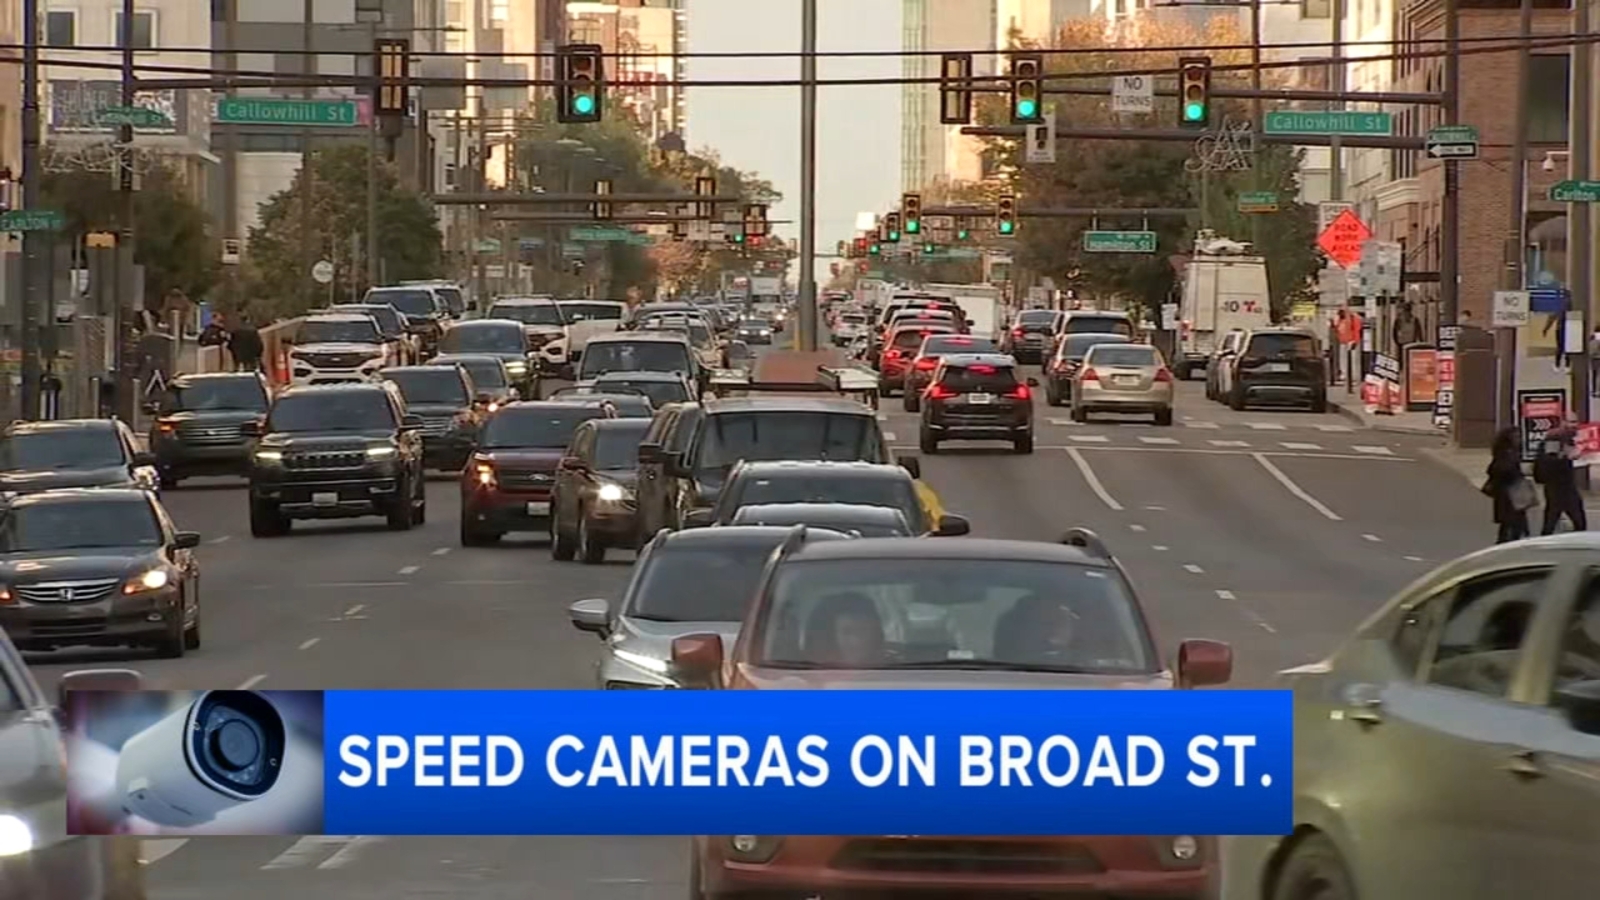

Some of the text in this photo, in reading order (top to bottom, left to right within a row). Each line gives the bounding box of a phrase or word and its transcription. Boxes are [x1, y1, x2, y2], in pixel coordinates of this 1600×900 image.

[1124, 78, 1142, 89] NO
[1116, 95, 1150, 106] TURNS
[226, 102, 346, 121] Callowhill St
[1272, 115, 1382, 130] Callowhill St
[1334, 223, 1358, 232] ROAD
[1089, 239, 1136, 250] Hamilton
[1331, 244, 1361, 252] AHEAD
[1504, 297, 1519, 307] NO
[1496, 311, 1526, 320] TURNS
